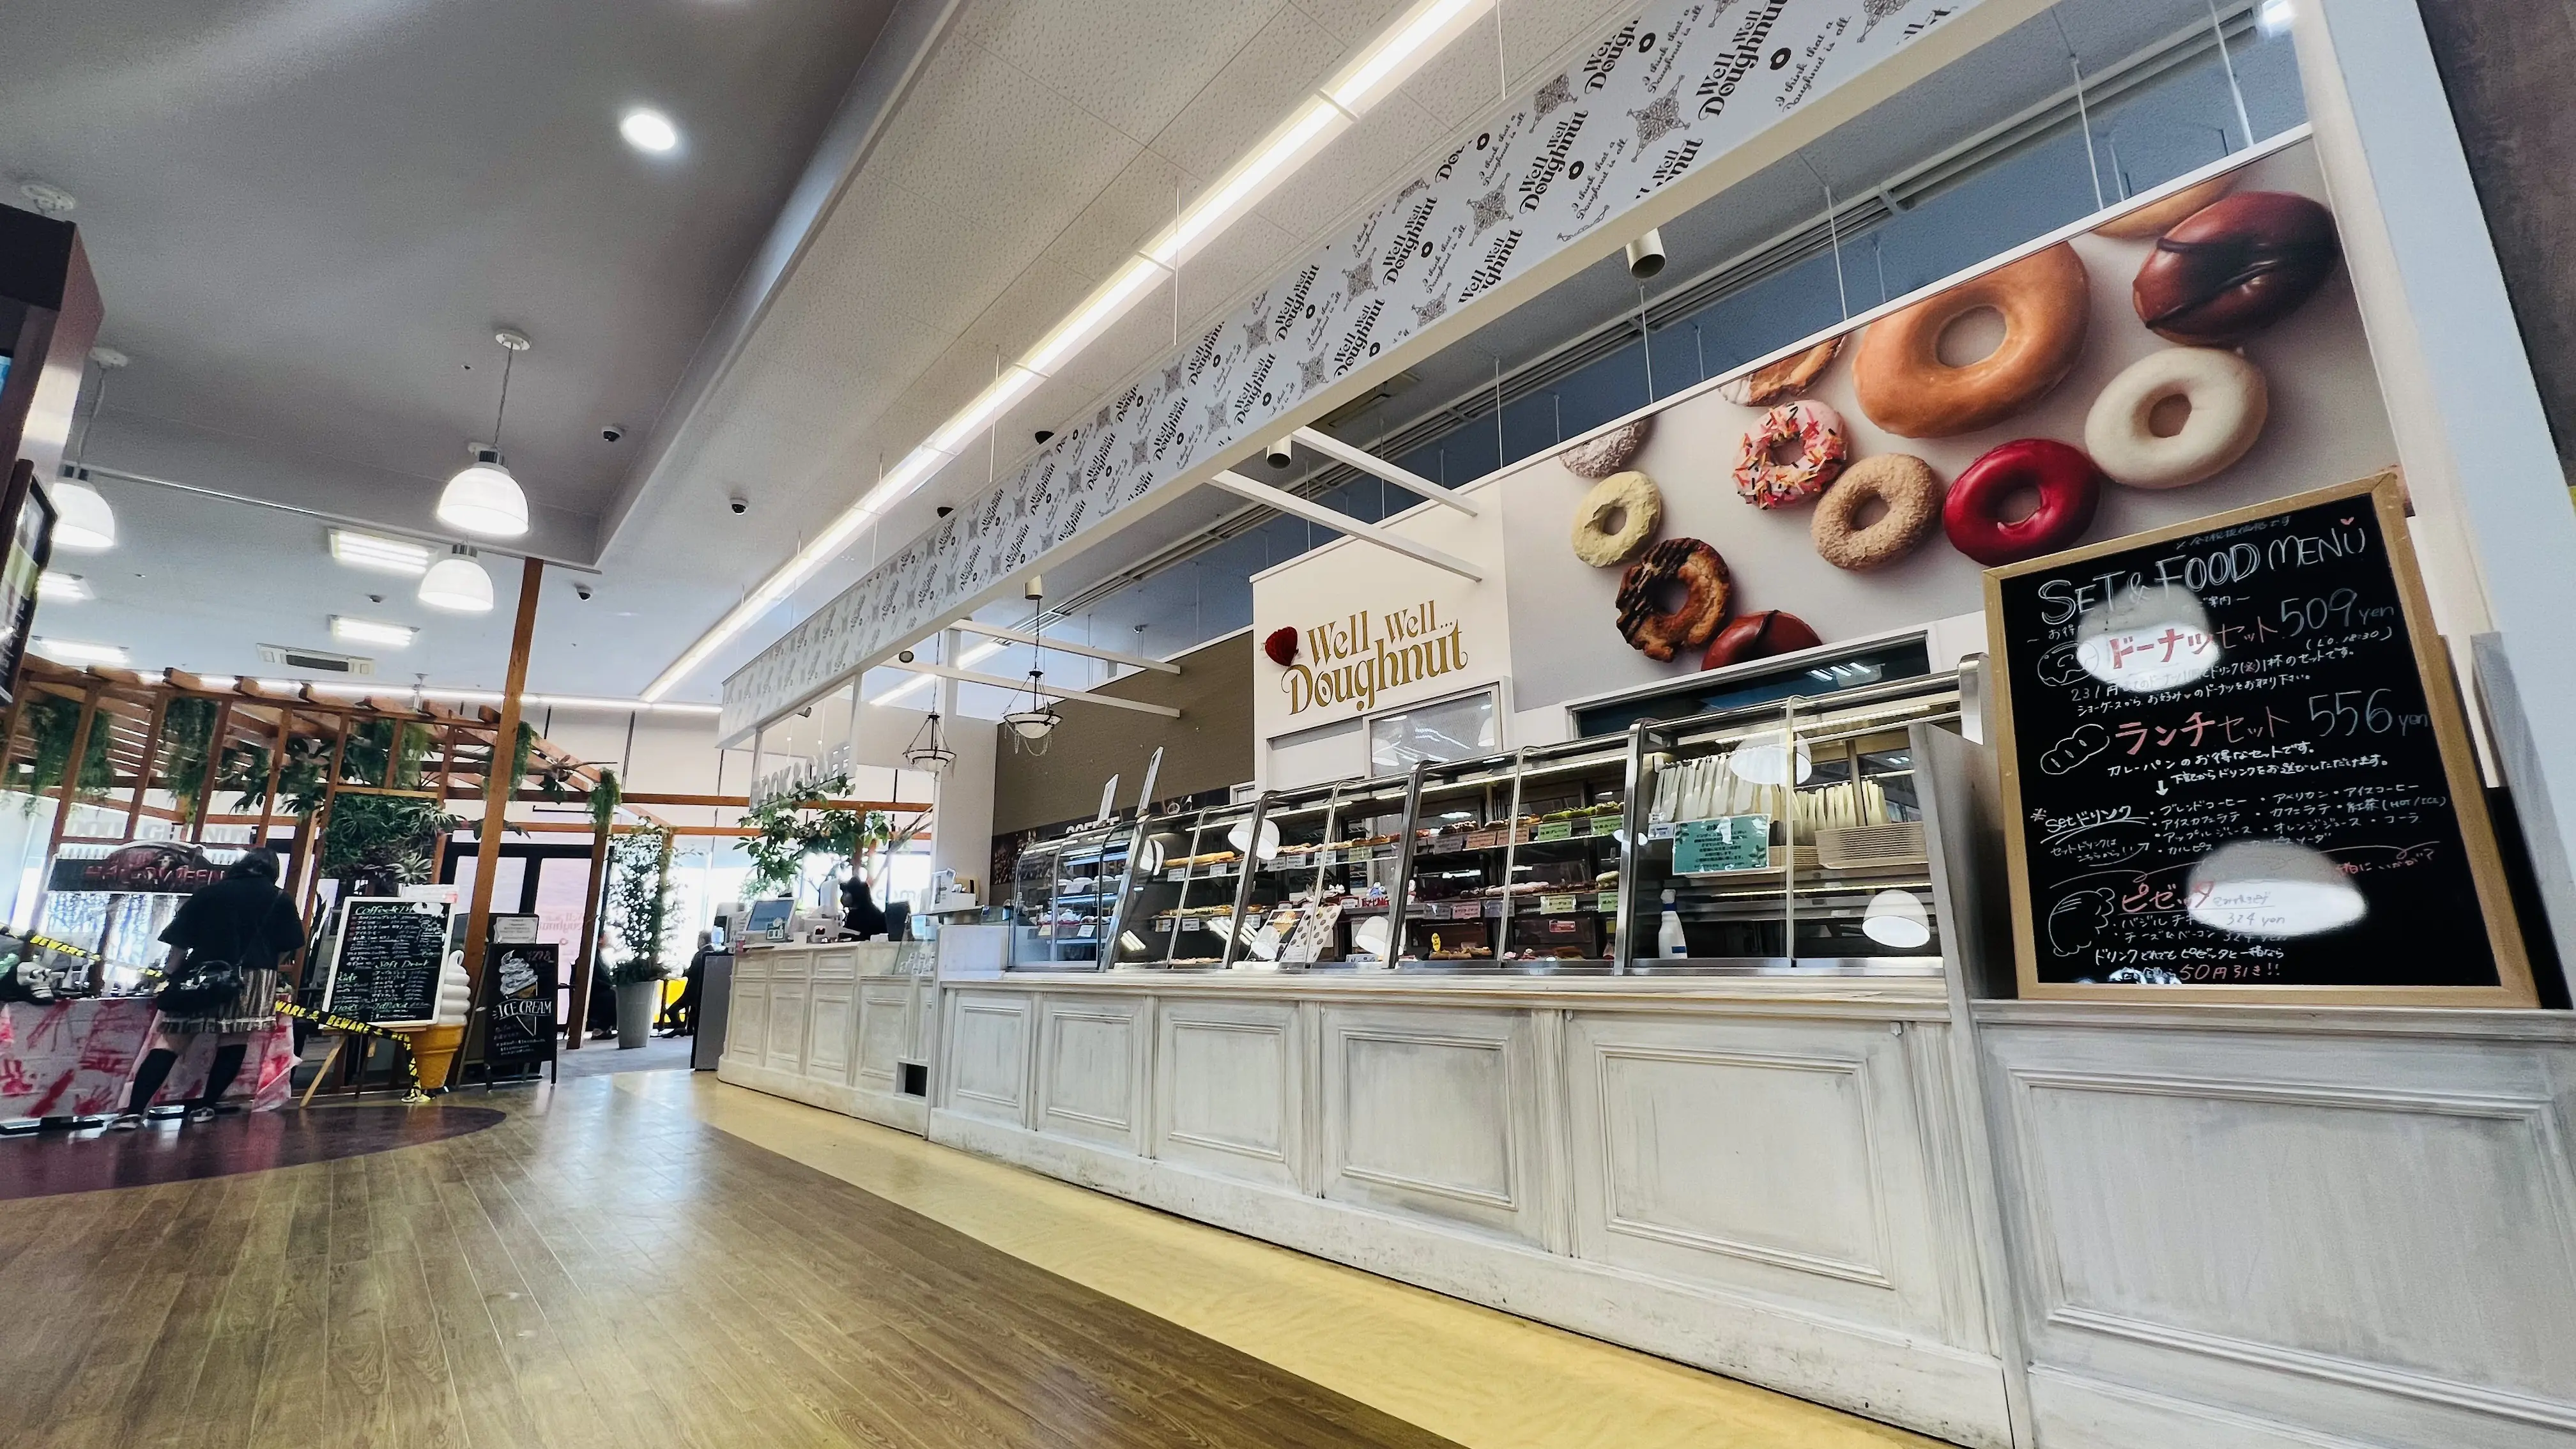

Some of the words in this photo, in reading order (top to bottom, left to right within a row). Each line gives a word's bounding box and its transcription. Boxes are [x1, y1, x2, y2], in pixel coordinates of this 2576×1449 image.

[1583, 34, 1617, 73] We
[1584, 19, 1639, 95] Doug
[1647, 41, 1683, 93] Doughnut
[1683, 27, 1691, 36] is
[1691, 4, 1705, 22] all
[1650, 47, 1668, 73] think
[1667, 20, 1683, 42] that
[1696, 53, 1735, 96] Well
[1732, 10, 1761, 45] Well
[1698, 0, 1788, 121] Doughnu
[1827, 41, 1836, 51] is
[1836, 16, 1851, 36] all
[1784, 63, 1807, 93] think
[1807, 33, 1825, 59] that
[1517, 111, 1526, 127] all
[1484, 146, 1499, 170] think
[1498, 126, 1510, 144] that
[1519, 156, 1549, 193] Well
[1547, 121, 1568, 148] Well
[1519, 110, 1588, 215] Doughnut
[1609, 159, 1616, 167] is
[1616, 138, 1629, 154] all
[1653, 149, 1680, 180] Well
[1578, 176, 1595, 201] think
[1595, 153, 1609, 172] that
[1383, 235, 1406, 266] Well
[1404, 205, 1423, 228] Well
[1383, 197, 1438, 286] Doughnut
[1458, 225, 1467, 238] all
[1275, 296, 1295, 325] Well
[1293, 270, 1308, 293] Well
[1458, 270, 1487, 303] Well
[1484, 238, 1505, 263] Well
[1275, 264, 1320, 342] Doughnut
[1188, 321, 1225, 387] Doughnu
[1188, 345, 1204, 371] Well
[1334, 332, 1356, 363] Well
[1354, 305, 1371, 329] Well
[1334, 298, 1385, 378] Doughnut
[1234, 382, 1252, 409] Well
[1252, 357, 1266, 378] Well
[1234, 353, 1276, 425] Doughnut
[2038, 571, 2126, 624] SET
[2127, 572, 2150, 604] &
[2153, 543, 2260, 599] FOOD
[2267, 528, 2366, 571] MENU
[1307, 610, 1370, 667] Well
[2281, 588, 2358, 638] 509
[2359, 607, 2395, 625] yen
[1281, 618, 1468, 716] Doughnut
[2115, 706, 2290, 755] ランチセット
[2308, 688, 2393, 737] 556
[2398, 714, 2428, 736] yen
[2227, 912, 2255, 926] 324
[2262, 916, 2285, 927] yen
[326, 1015, 371, 1034] BEWARE
[498, 1001, 519, 1018] ICE
[519, 1000, 552, 1015] CREAM
